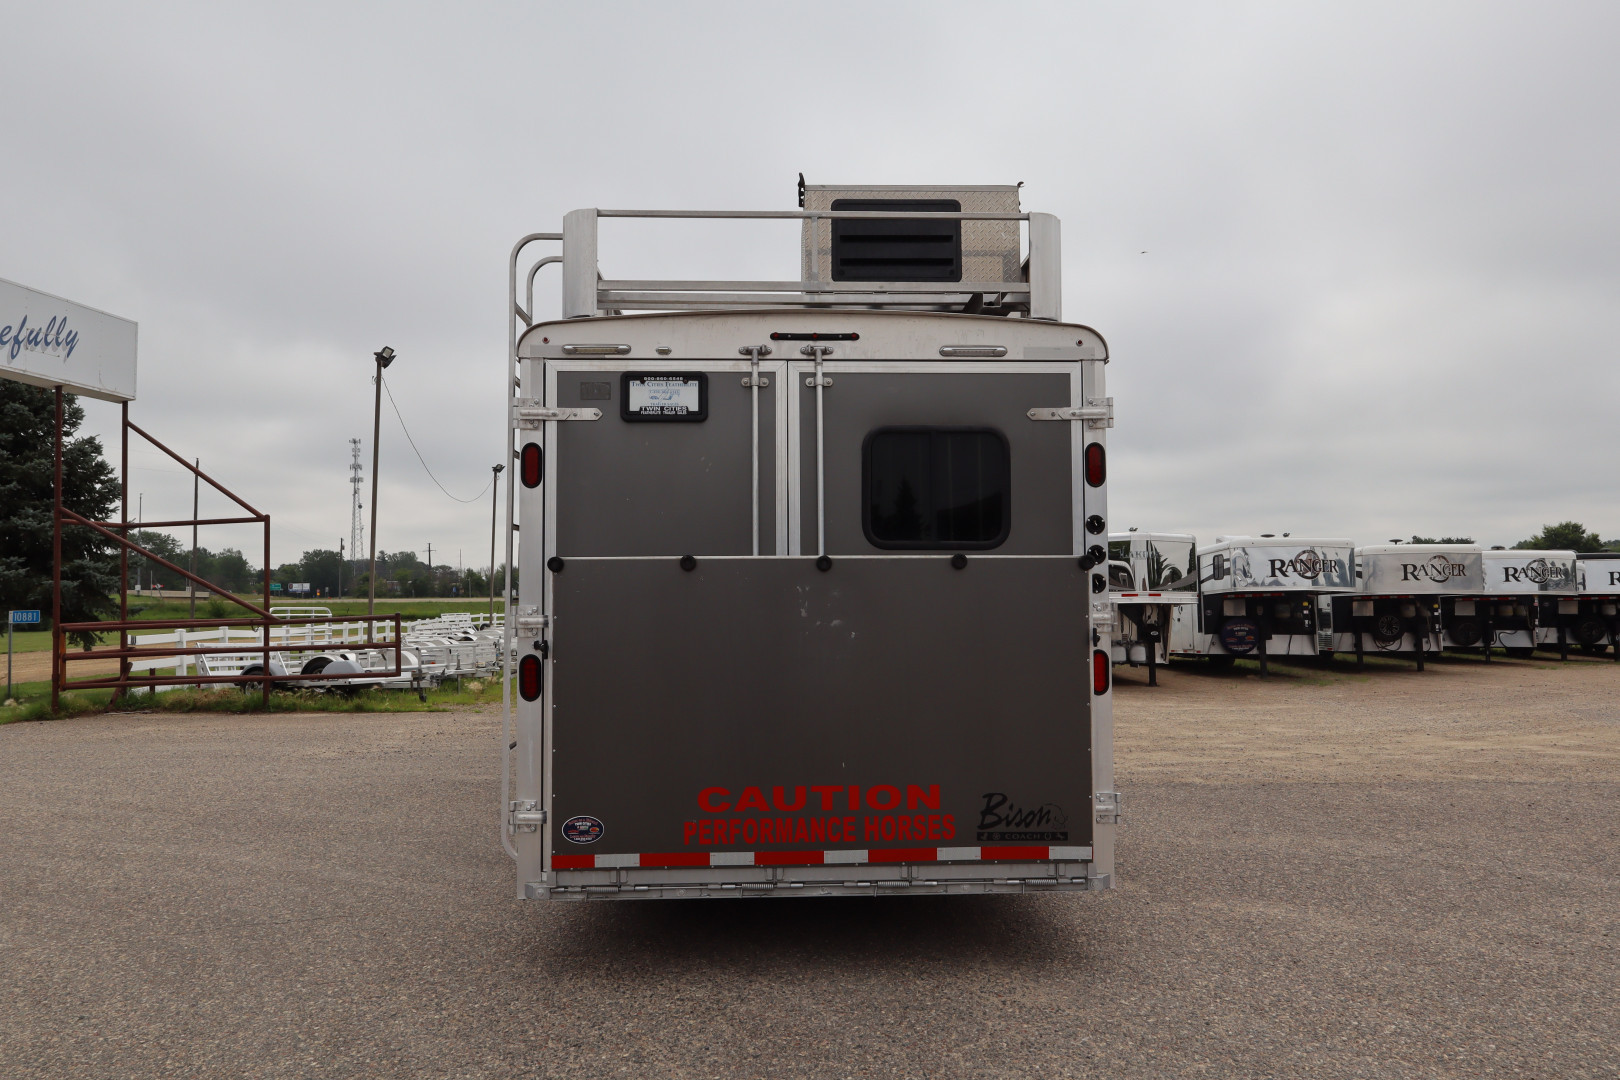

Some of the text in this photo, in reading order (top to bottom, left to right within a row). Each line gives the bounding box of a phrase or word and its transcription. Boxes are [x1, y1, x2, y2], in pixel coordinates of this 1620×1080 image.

[1268, 558, 1339, 578] RANGER
[1400, 563, 1467, 581] RANGER
[1502, 566, 1564, 583] RANGER
[14, 612, 37, 622] 10881
[697, 784, 941, 813] CAUTION
[976, 792, 1051, 830] Bison
[683, 813, 956, 845] PERFORMANCE HORSES
[1004, 832, 1041, 840] COACH
